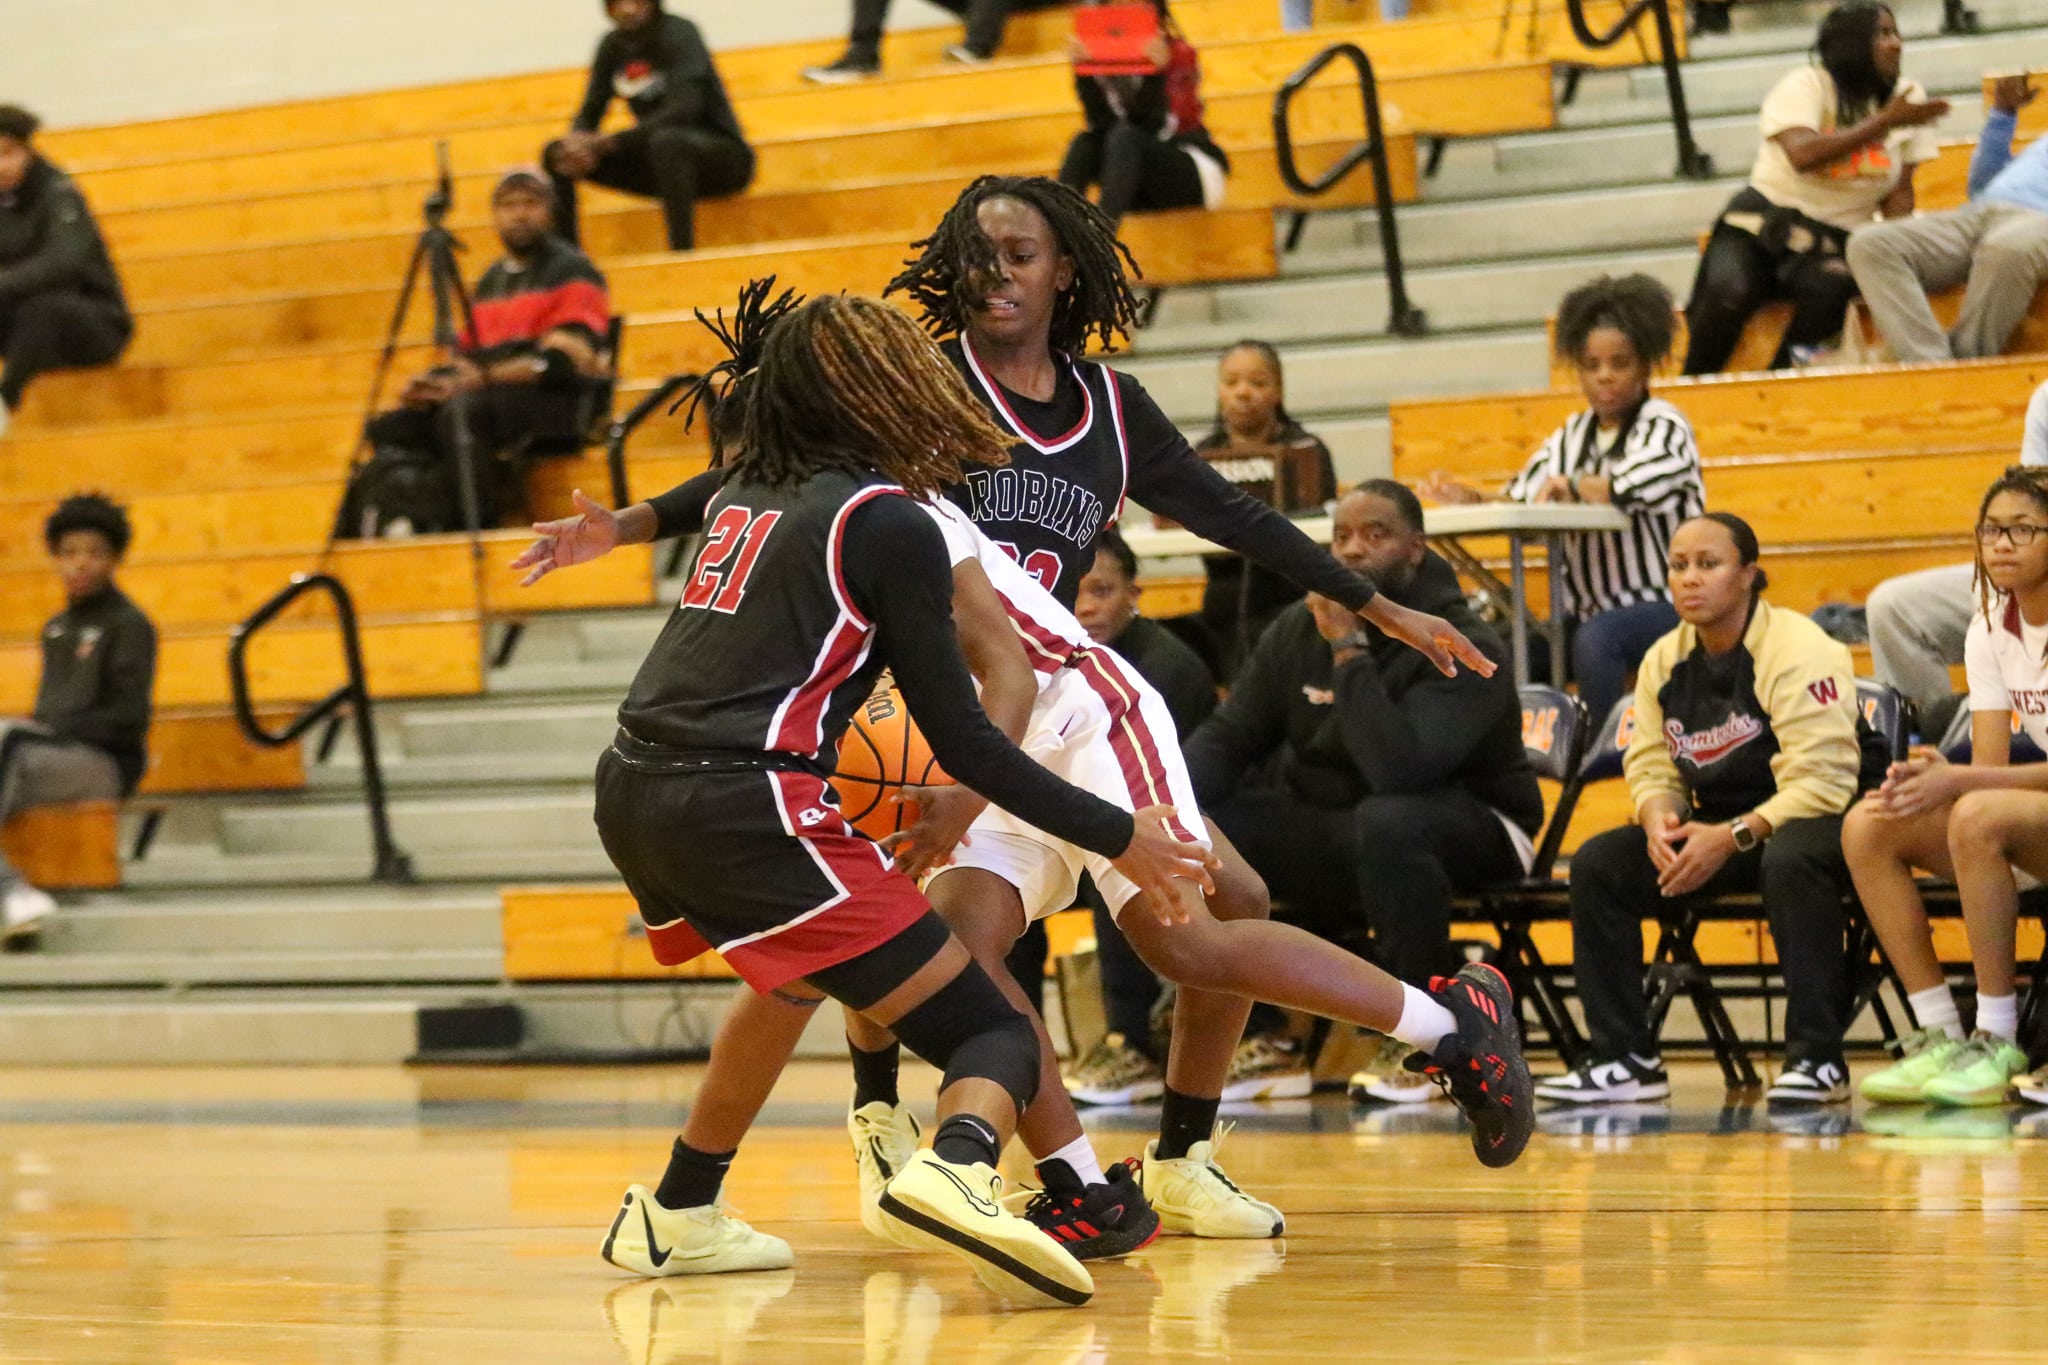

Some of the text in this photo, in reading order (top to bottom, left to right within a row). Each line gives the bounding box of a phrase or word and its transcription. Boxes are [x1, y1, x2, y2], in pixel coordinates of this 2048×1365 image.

[966, 468, 1102, 549] ROBINS
[680, 505, 783, 615] 21
[1807, 676, 1839, 706] W
